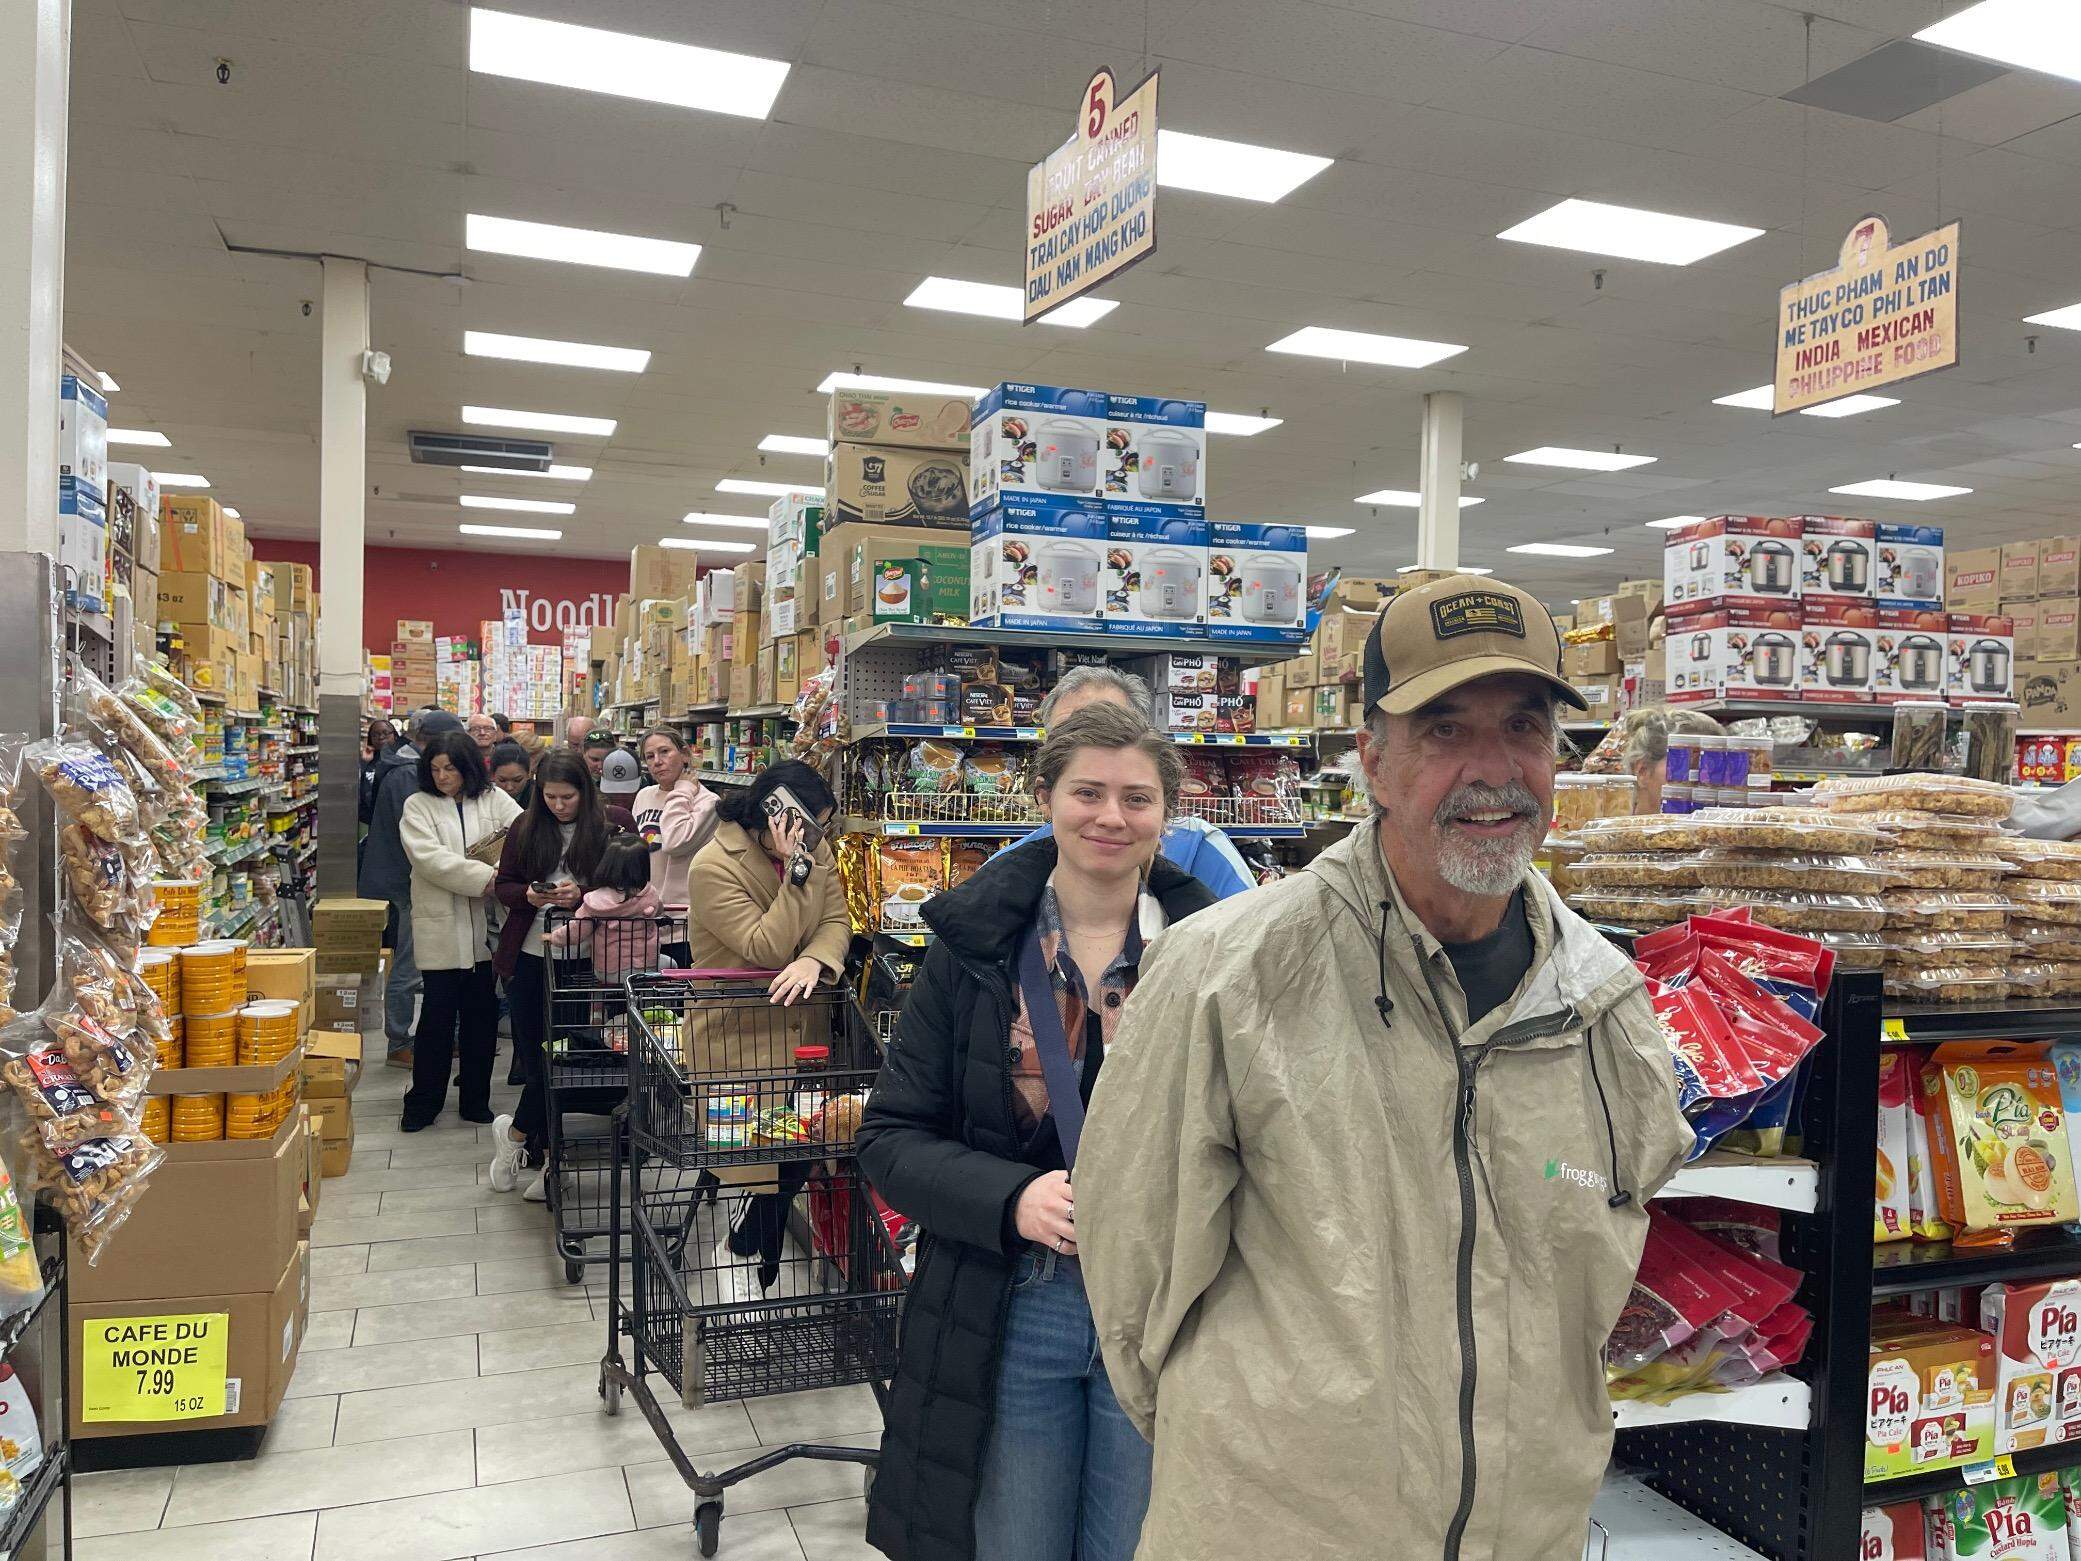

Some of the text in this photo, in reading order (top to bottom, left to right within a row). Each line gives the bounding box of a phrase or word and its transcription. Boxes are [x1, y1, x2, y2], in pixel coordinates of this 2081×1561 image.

[1088, 78, 1105, 138] 5
[1030, 174, 1150, 271] TRAI CAY HOP DUONG
[1033, 198, 1074, 239] SUGAR
[1085, 235, 1119, 274] MANG
[1121, 210, 1146, 249] KHO
[1854, 222, 1875, 268] 7
[1788, 244, 1949, 322] THUC PHAM AN DO
[1795, 308, 1935, 372] INDIA MEXICAN
[1789, 333, 1942, 399] PHILIPPINE FOOD
[1014, 384, 1036, 394] TIGER
[1117, 396, 1138, 405] TIGER
[1002, 495, 1021, 503] MADE
[1030, 496, 1047, 504] JAPAN
[1143, 506, 1162, 514] JAPON
[1016, 508, 1036, 517] TIGER
[1119, 516, 1140, 525] TIGER
[1020, 524, 1068, 533] cooker/warmer
[1221, 524, 1242, 532] TIGER
[1956, 572, 1993, 586] KOPIKO
[500, 588, 613, 632] Noodl
[1440, 596, 1516, 618] OCEAN COAST
[1004, 618, 1022, 626] MADE
[1030, 619, 1048, 627] JAPAN
[2025, 682, 2058, 700] PANDA
[104, 1321, 208, 1343] CAFE DU
[2041, 1305, 2077, 1339] Pía
[2041, 1335, 2076, 1351] ピアケーキ
[112, 1346, 199, 1368] MONDE
[136, 1369, 175, 1395] 7.99
[1939, 1377, 1952, 1389] Pía
[174, 1396, 204, 1412] 15 OZ
[1871, 1384, 1909, 1417] Pía
[1870, 1415, 1908, 1430] ピアケーキ
[1924, 1429, 1939, 1442] Pía
[1984, 1505, 2033, 1548] Pía
[1861, 1529, 1882, 1561] ía
[1989, 1538, 2037, 1559] Custard Hopia
